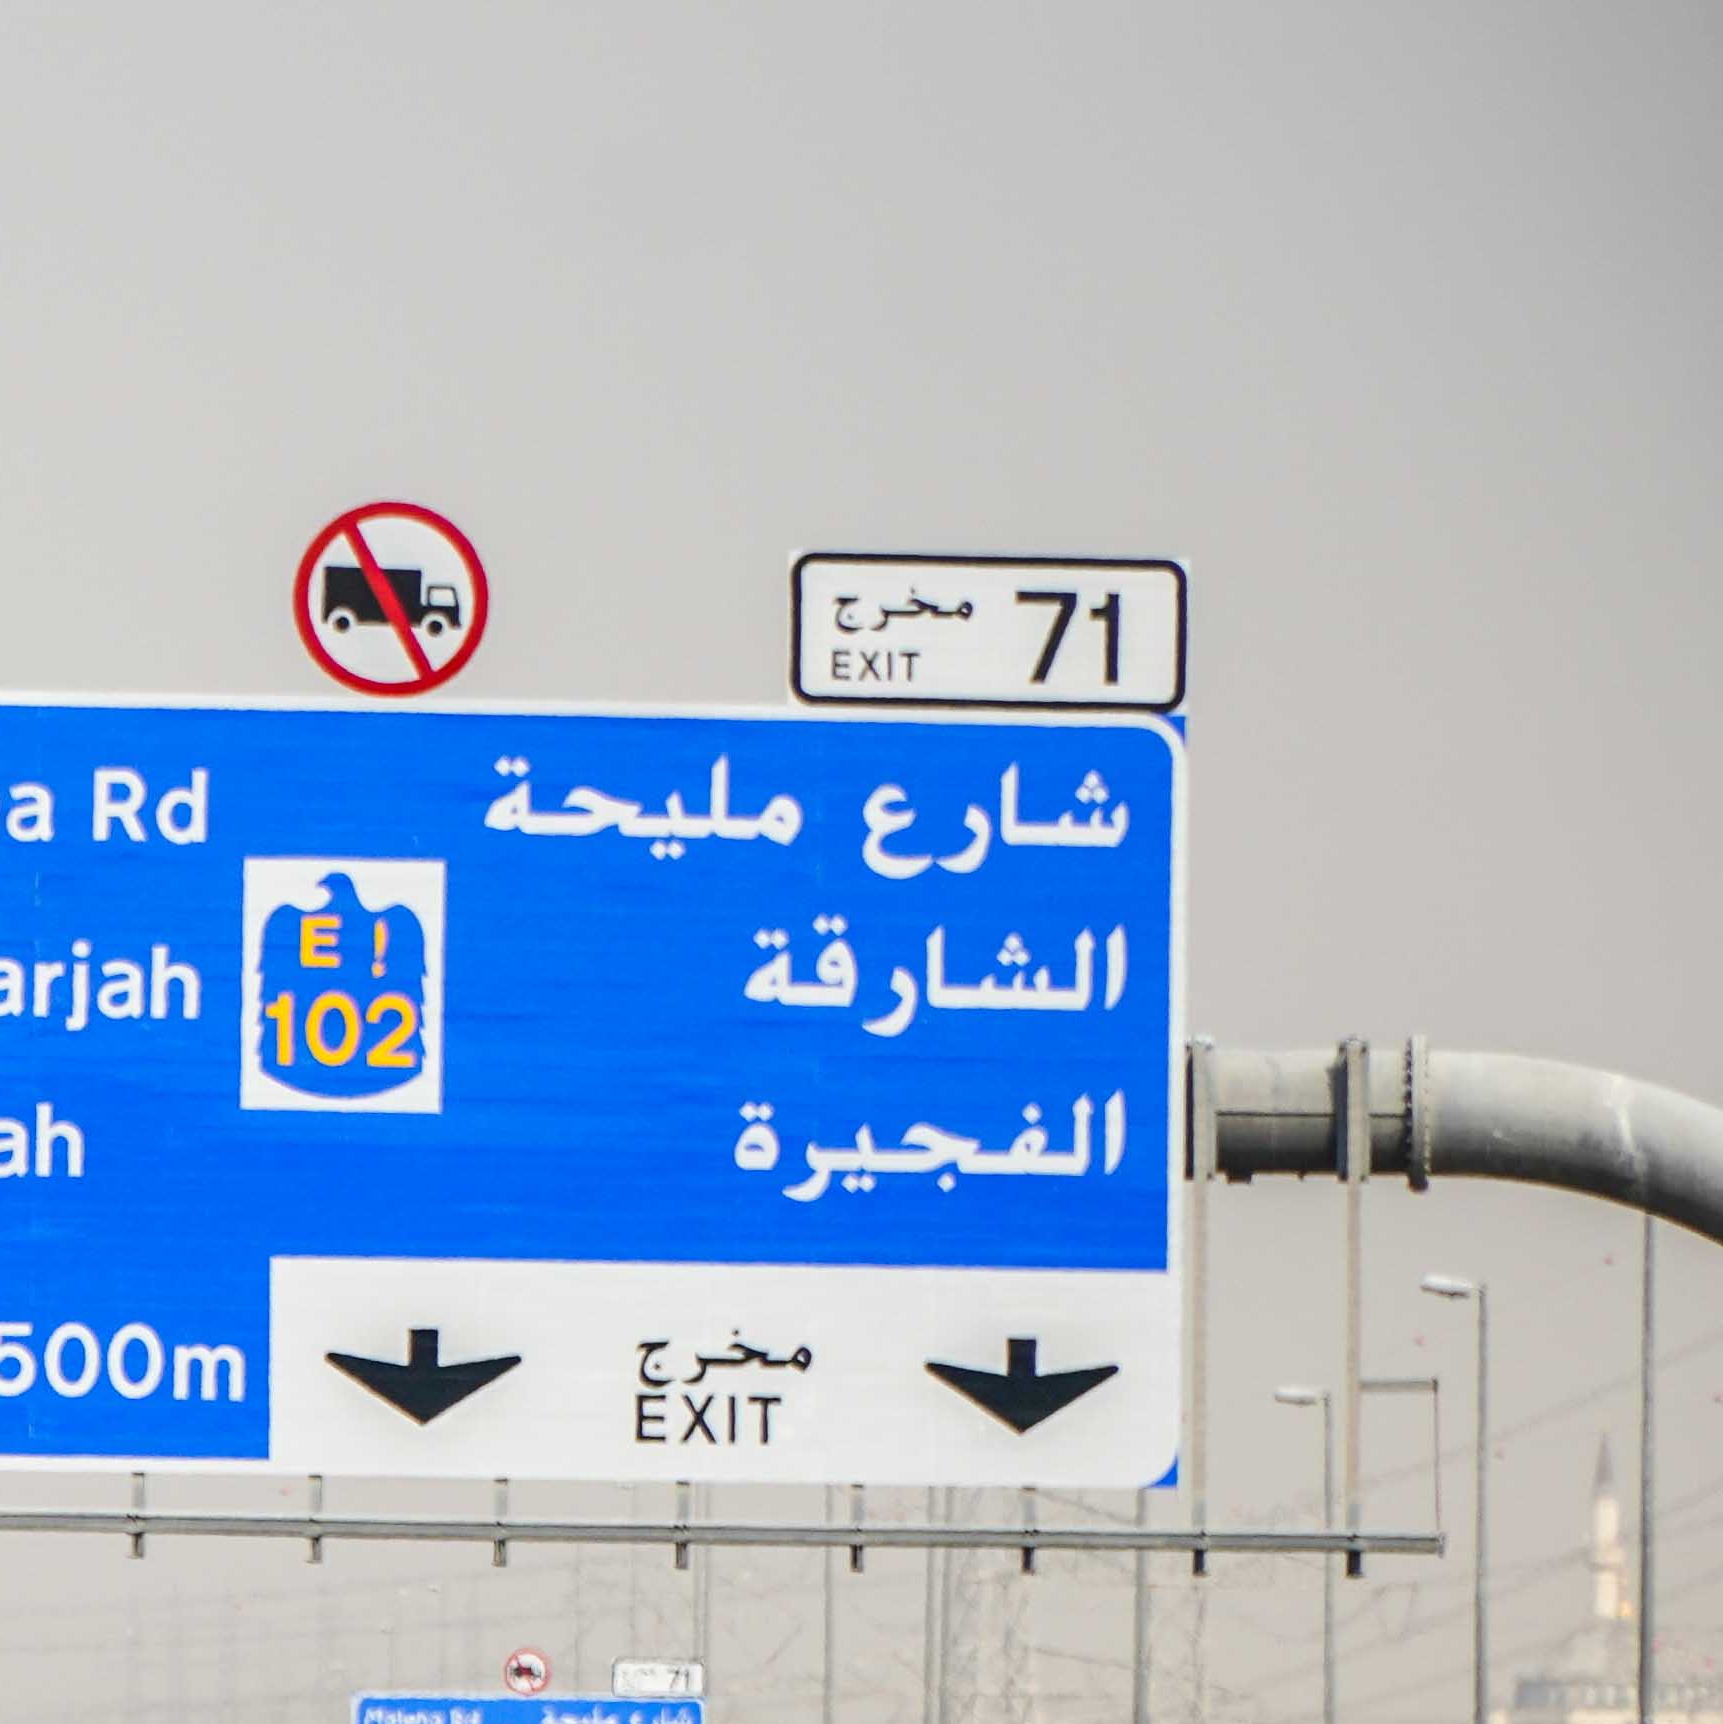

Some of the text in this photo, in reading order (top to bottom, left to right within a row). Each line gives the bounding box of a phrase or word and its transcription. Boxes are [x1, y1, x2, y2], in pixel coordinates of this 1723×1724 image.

[834, 591, 974, 633] مخرج
[1015, 590, 1121, 685] 71
[831, 651, 920, 681] EXIT
[91, 765, 210, 847] Rd
[482, 754, 1130, 881] شارع مليحة
[298, 916, 340, 969] E
[743, 914, 1129, 1039] الشارقة
[264, 992, 417, 1069] 102
[733, 1089, 1127, 1203] الفجيرة
[638, 1329, 813, 1388] مخرج
[635, 1395, 783, 1445] EXIT
[666, 1668, 691, 1692] 71
